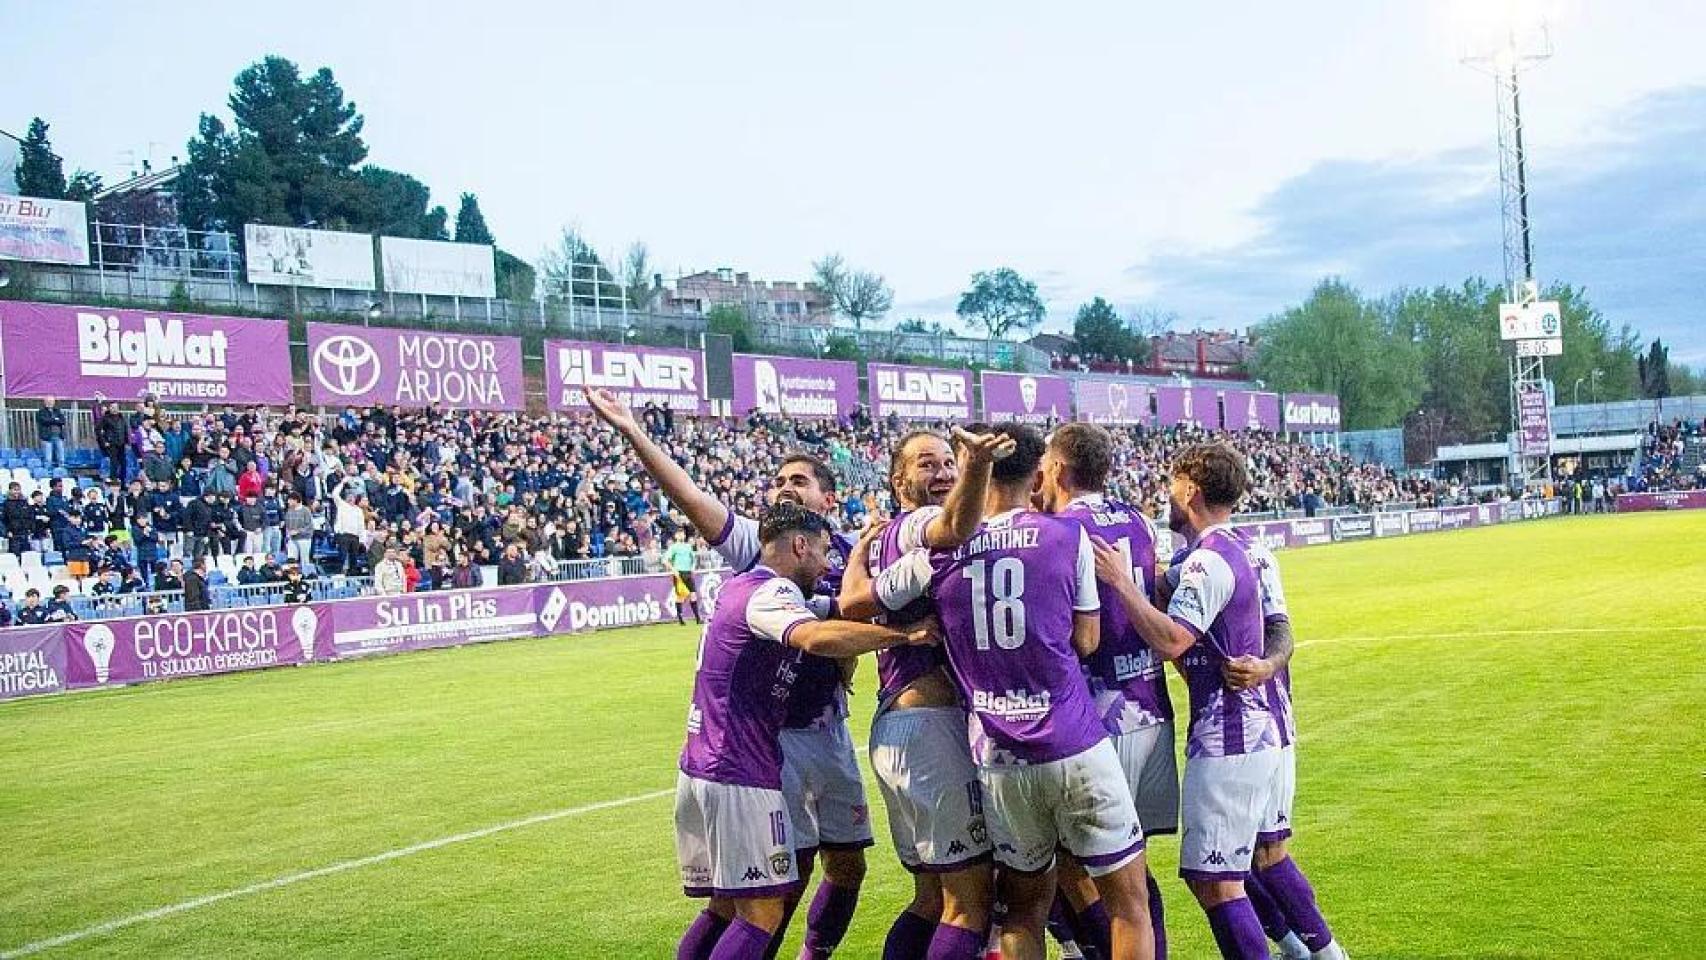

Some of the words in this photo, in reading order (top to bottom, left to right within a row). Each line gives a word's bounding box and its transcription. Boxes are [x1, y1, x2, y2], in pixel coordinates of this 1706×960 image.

[77, 312, 228, 377] BigMat
[399, 335, 498, 372] MOTOR
[149, 382, 227, 397] REVIRIEGO
[396, 369, 505, 404] ARJONA
[376, 600, 410, 627] Su
[417, 598, 443, 624] In
[449, 594, 497, 621] Plas
[570, 594, 661, 630] Domino's
[963, 557, 1026, 650] 18
[141, 660, 158, 678] TU
[1114, 649, 1155, 682] BigM
[973, 688, 1052, 716] BigMat
[768, 809, 786, 847] 16
